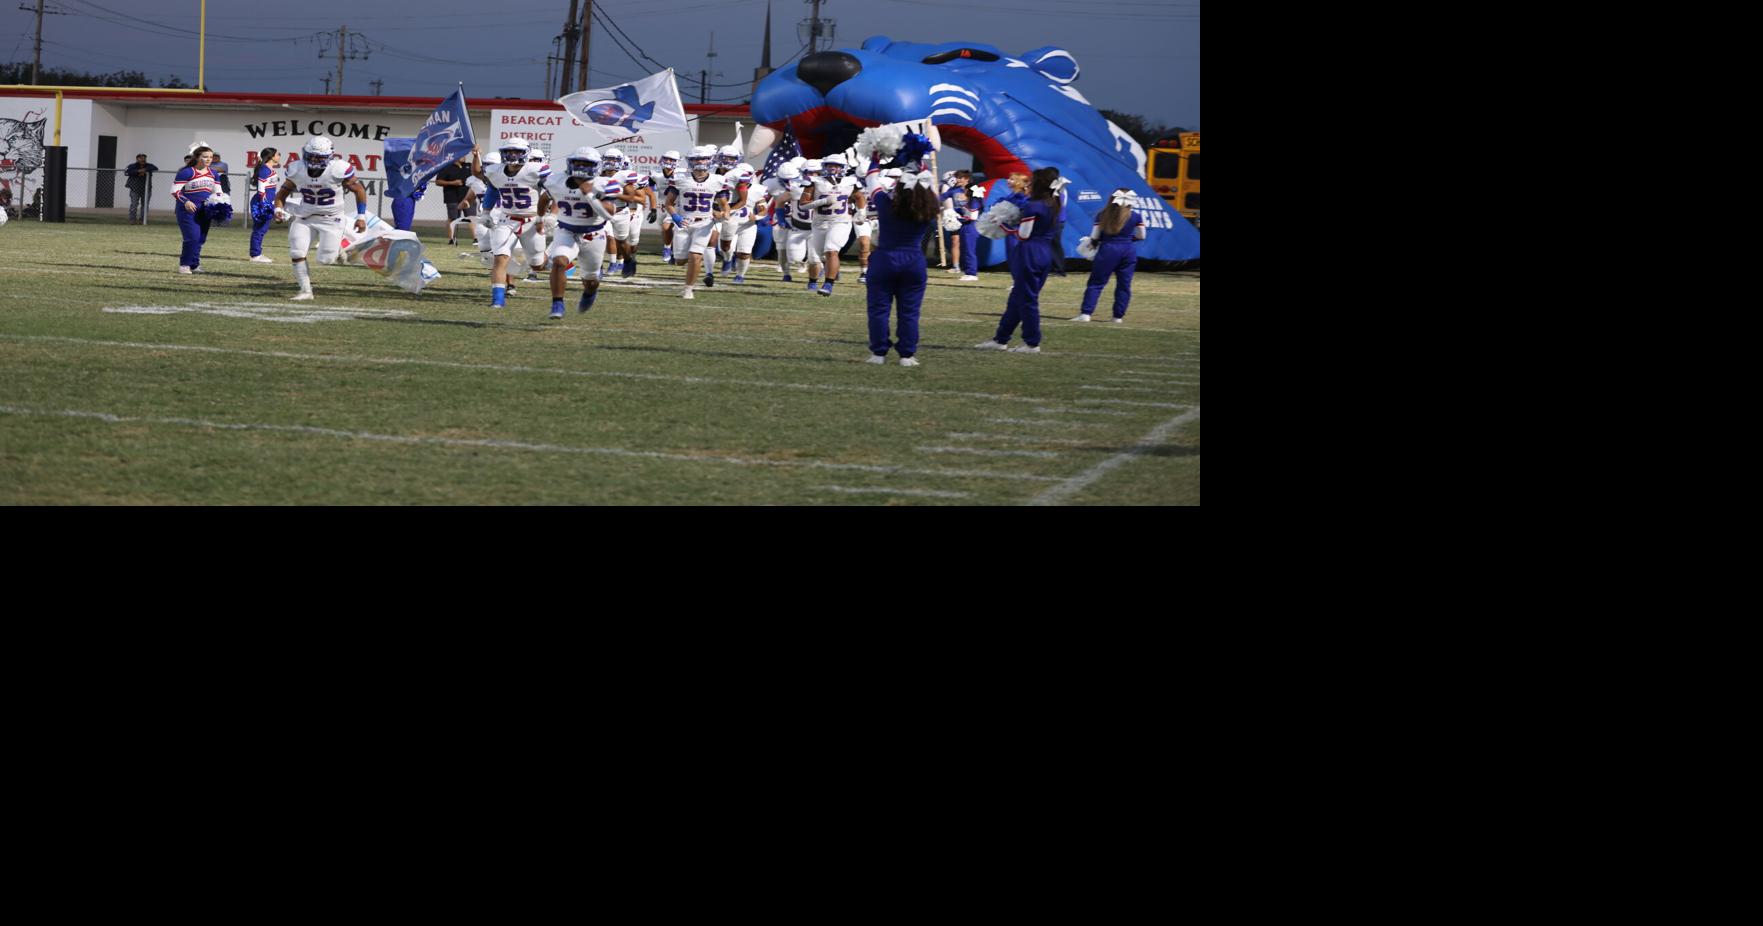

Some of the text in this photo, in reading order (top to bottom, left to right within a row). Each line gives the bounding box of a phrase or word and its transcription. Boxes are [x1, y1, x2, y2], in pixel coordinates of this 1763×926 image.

[245, 119, 391, 141] WELCOME
[501, 115, 564, 126] BEARCAT
[501, 131, 554, 141] DISTRICT
[300, 188, 336, 206] 62
[499, 187, 532, 209] 55
[683, 191, 714, 212] 35
